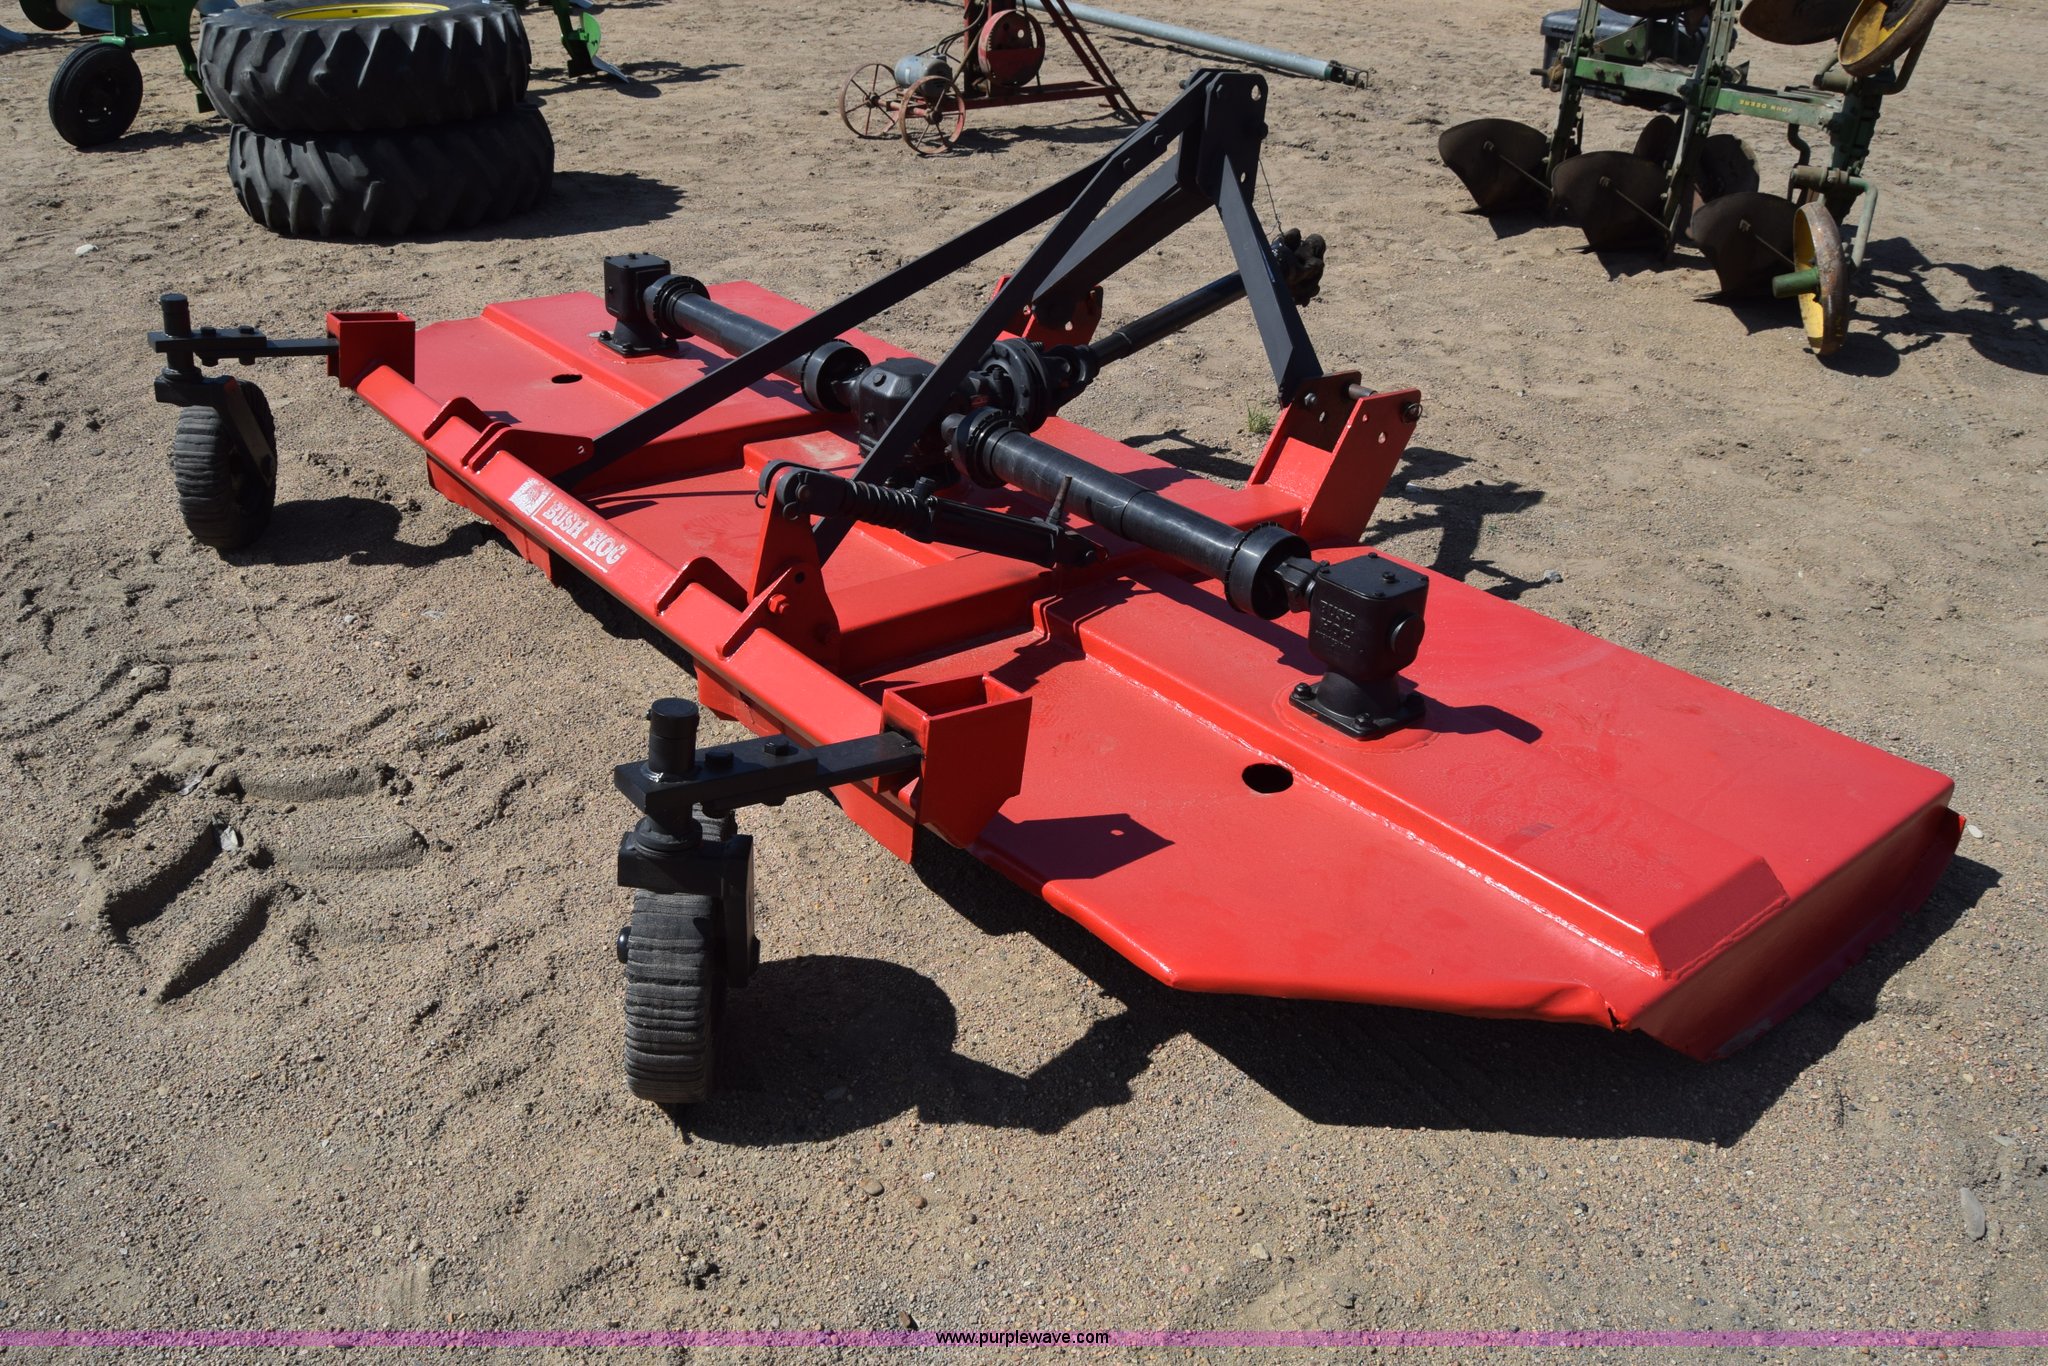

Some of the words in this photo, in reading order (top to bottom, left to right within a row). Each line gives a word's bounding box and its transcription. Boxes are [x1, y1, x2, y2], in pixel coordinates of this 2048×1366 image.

[1739, 99, 1767, 109] DEERE
[1770, 105, 1793, 113] JOHN
[542, 501, 590, 540] BUSH
[582, 527, 628, 565] HOG
